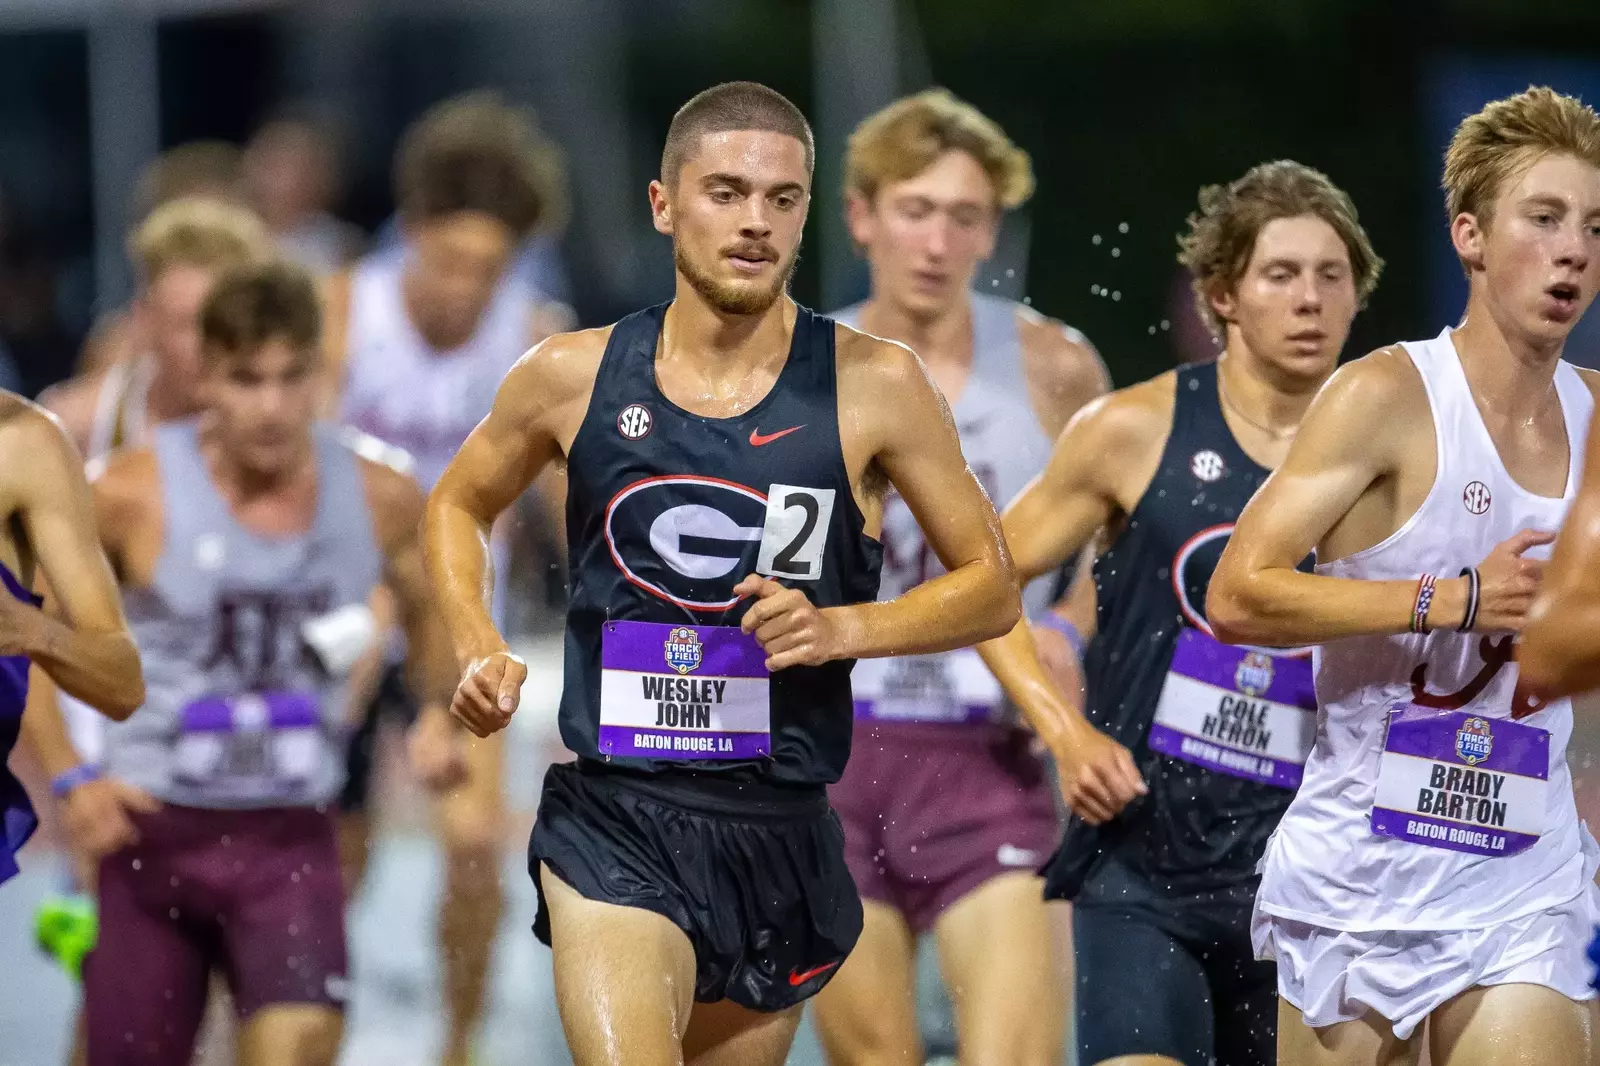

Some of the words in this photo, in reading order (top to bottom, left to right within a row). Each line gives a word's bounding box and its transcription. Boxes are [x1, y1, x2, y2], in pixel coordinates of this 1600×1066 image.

[620, 406, 651, 438] SEC
[1463, 481, 1491, 514] SEC
[650, 504, 763, 579] G
[771, 492, 819, 574] 2
[667, 643, 699, 653] TRACK
[674, 652, 700, 661] FIELD
[642, 676, 727, 704] WESLEY
[656, 703, 711, 728] JOHN
[1219, 696, 1271, 725] COLE
[634, 734, 672, 749] BATON
[674, 737, 716, 752] ROUGE,
[719, 738, 733, 751] LA
[1202, 714, 1272, 750] HERON
[1459, 732, 1490, 746] TRACK
[1465, 742, 1490, 754] FIELD
[1429, 764, 1505, 799] BRADY
[1417, 788, 1507, 827] BARTON
[1407, 820, 1448, 841] BATON
[1448, 828, 1489, 849] ROUGE,
[1492, 836, 1506, 850] LA
